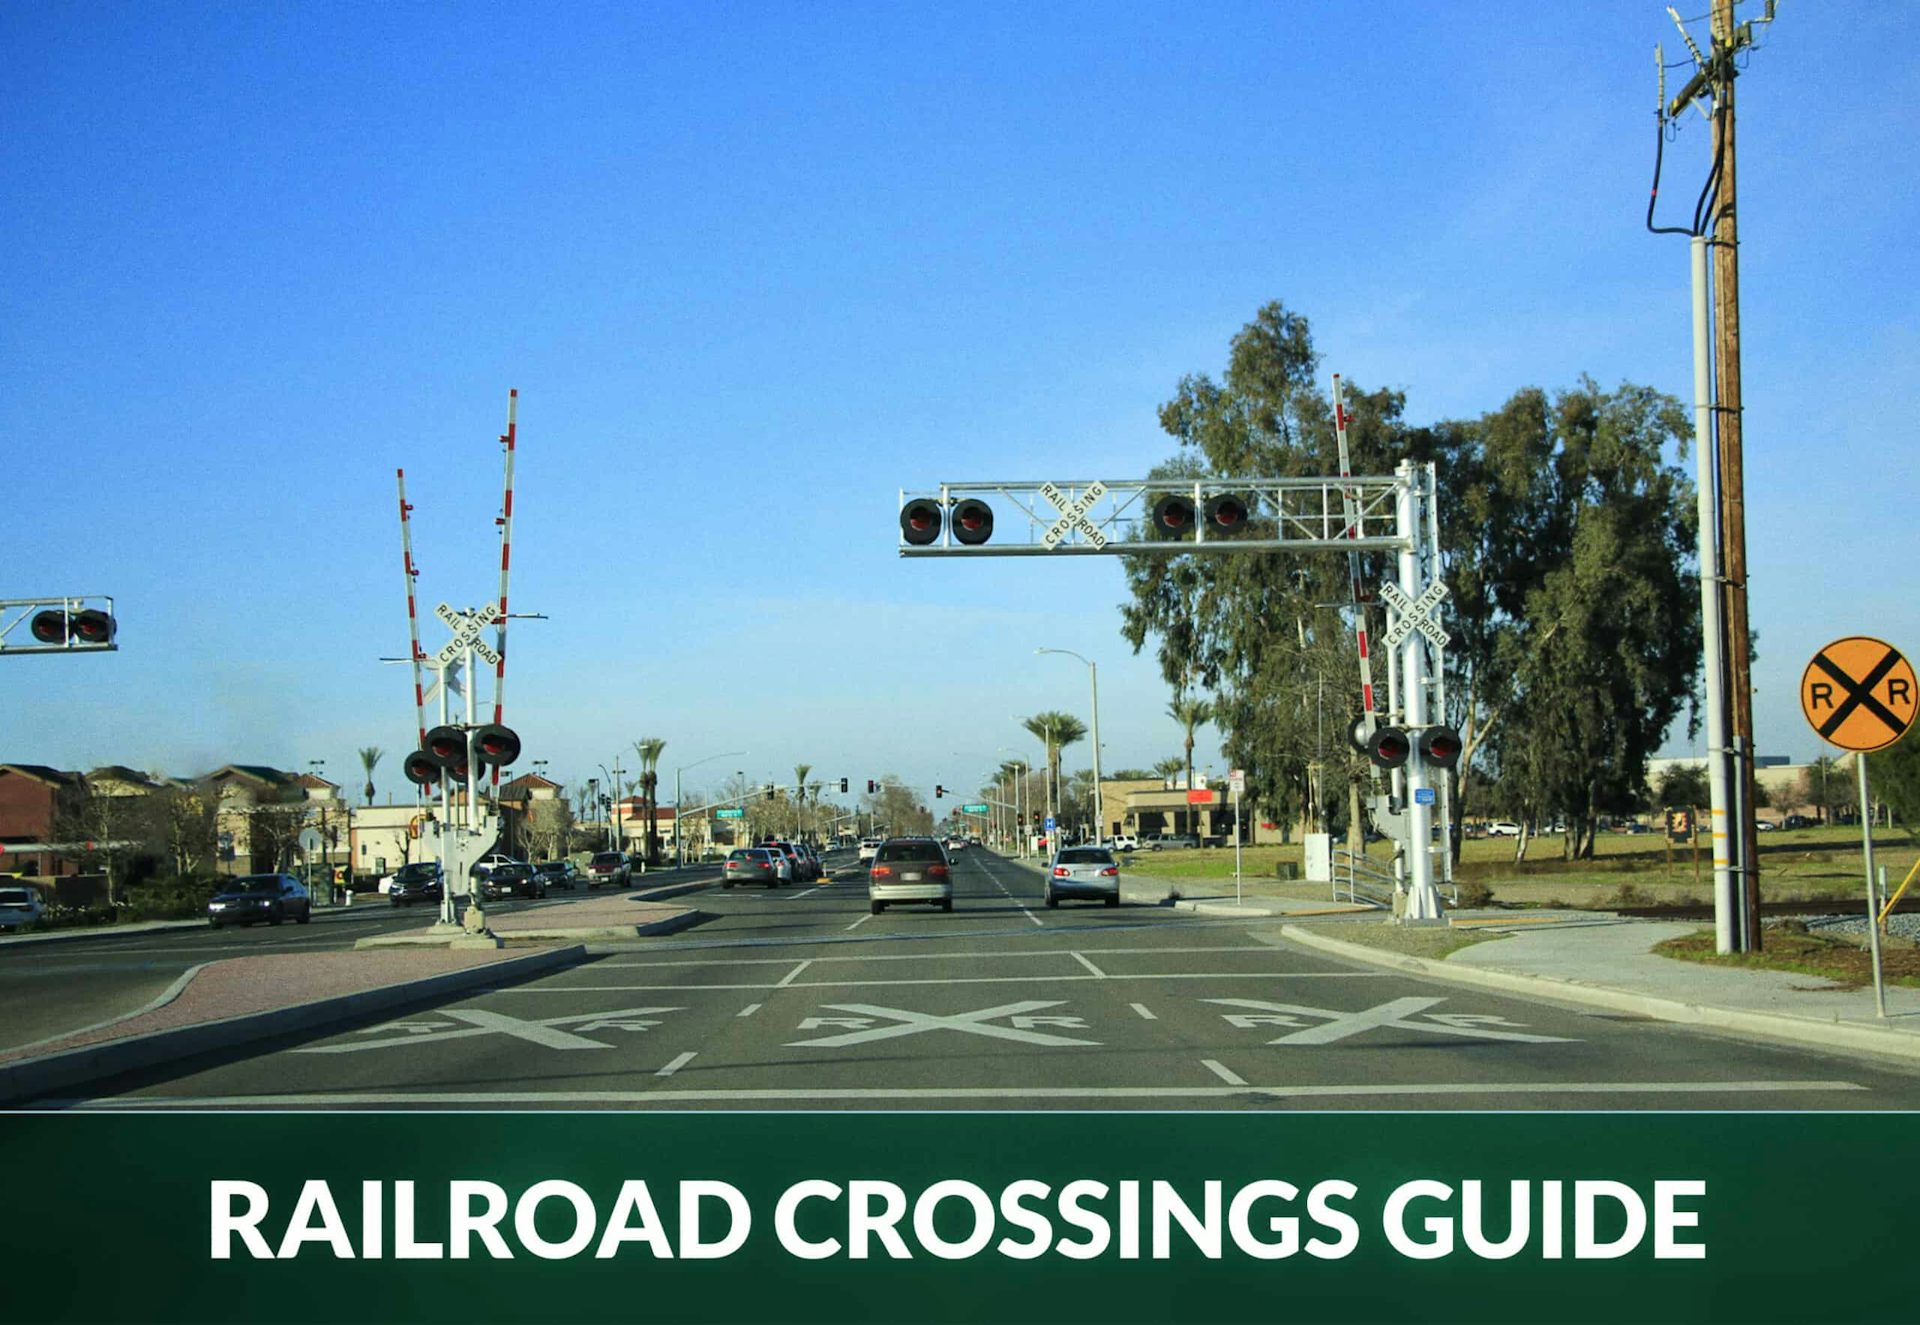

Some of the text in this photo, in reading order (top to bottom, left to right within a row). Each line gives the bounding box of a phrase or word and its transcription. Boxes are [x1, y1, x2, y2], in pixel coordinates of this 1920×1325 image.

[1041, 484, 1105, 546] RAIL ROAD
[1045, 486, 1102, 544] CROSSING
[437, 604, 499, 666] RAIL ROAD
[439, 606, 497, 663] CROSSING
[1383, 585, 1447, 646] RAIL ROAD
[1387, 586, 1443, 645] CROSSING
